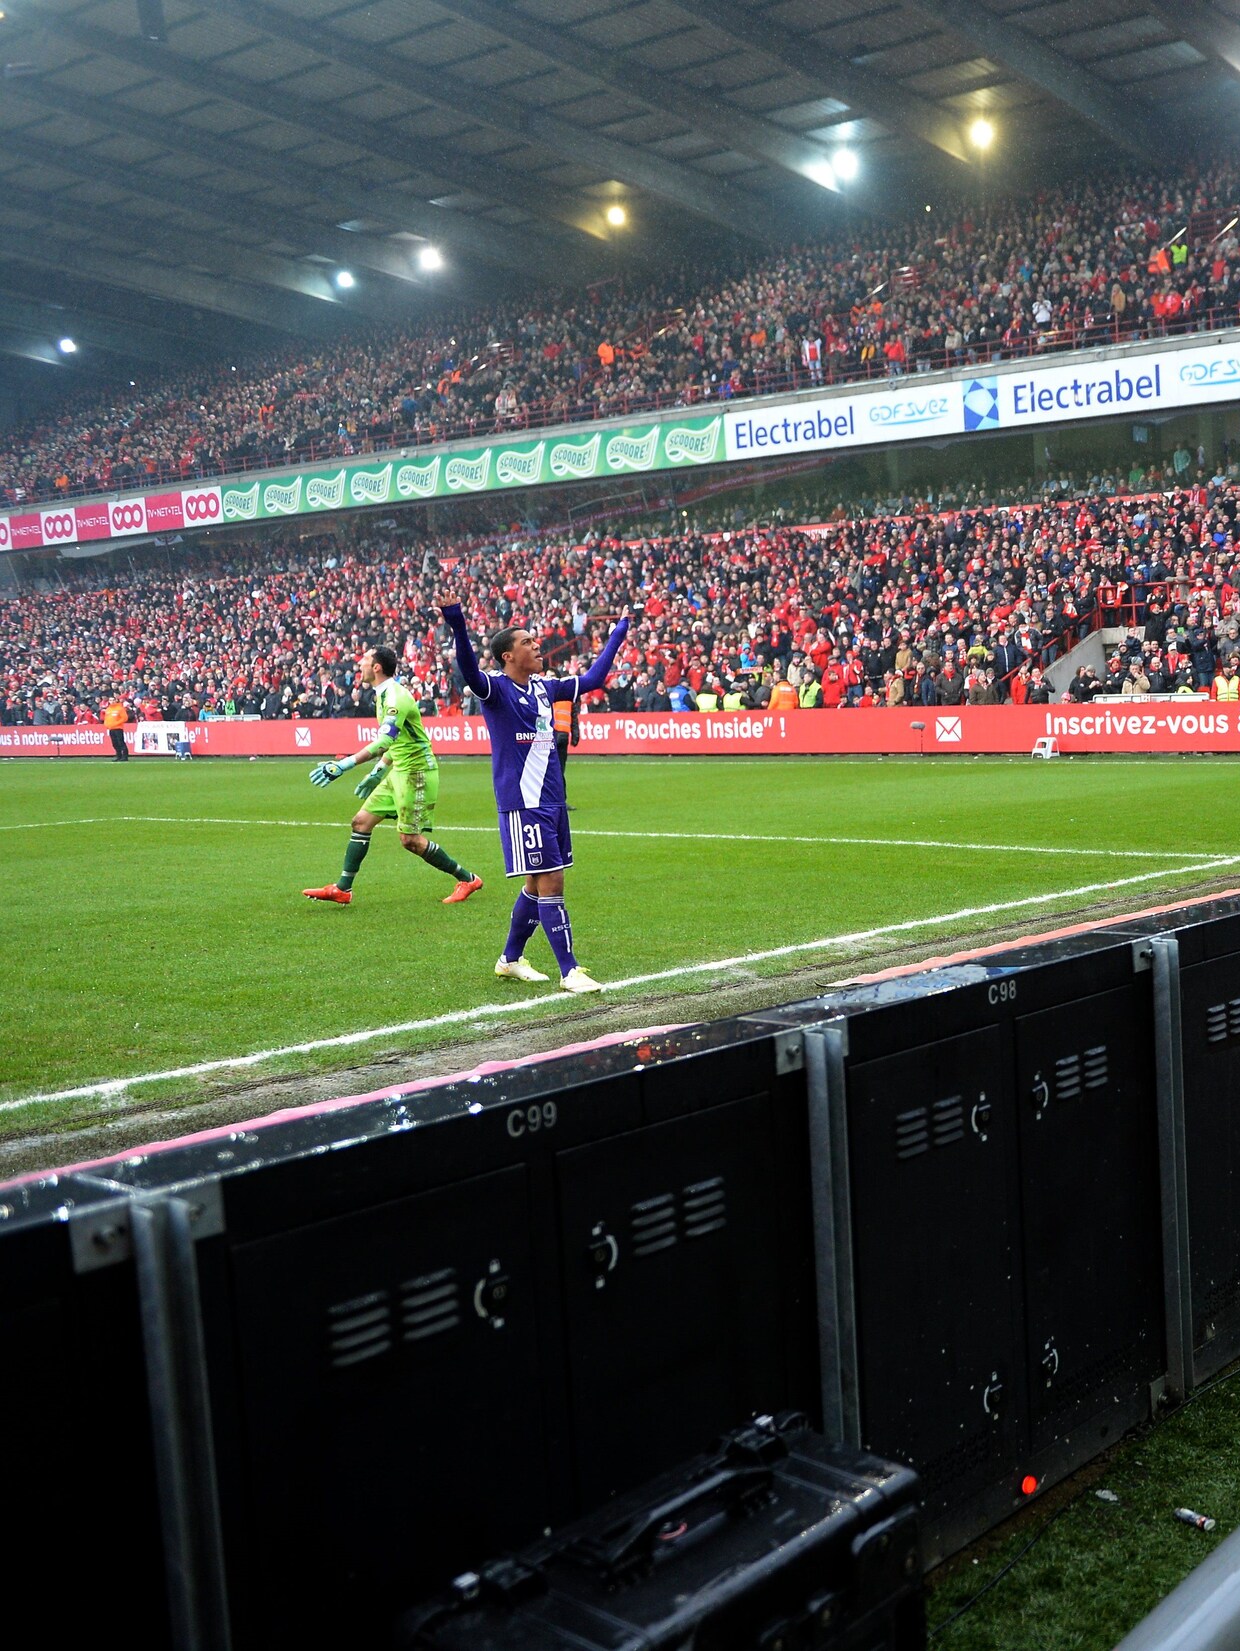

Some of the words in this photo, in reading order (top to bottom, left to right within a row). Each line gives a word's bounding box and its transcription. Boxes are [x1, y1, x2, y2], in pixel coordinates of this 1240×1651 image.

[1013, 364, 1161, 414] Electrabel
[735, 406, 855, 449] Electrabel
[610, 441, 649, 459] SCOOORE!
[669, 433, 711, 452] SCOOORE!
[500, 455, 536, 473] SCOOORE!
[554, 448, 591, 466] SCOOORE!
[448, 462, 483, 481] SCOOORE!
[464, 722, 473, 741] à
[615, 719, 701, 740] "Rouches
[706, 717, 773, 739] Inside"
[1045, 711, 1229, 735] Inscrivez-vous
[22, 732, 48, 746] notre
[516, 732, 536, 741] BNP
[523, 824, 543, 849] 31
[988, 979, 1017, 1005] C98
[506, 1100, 558, 1138] C99
